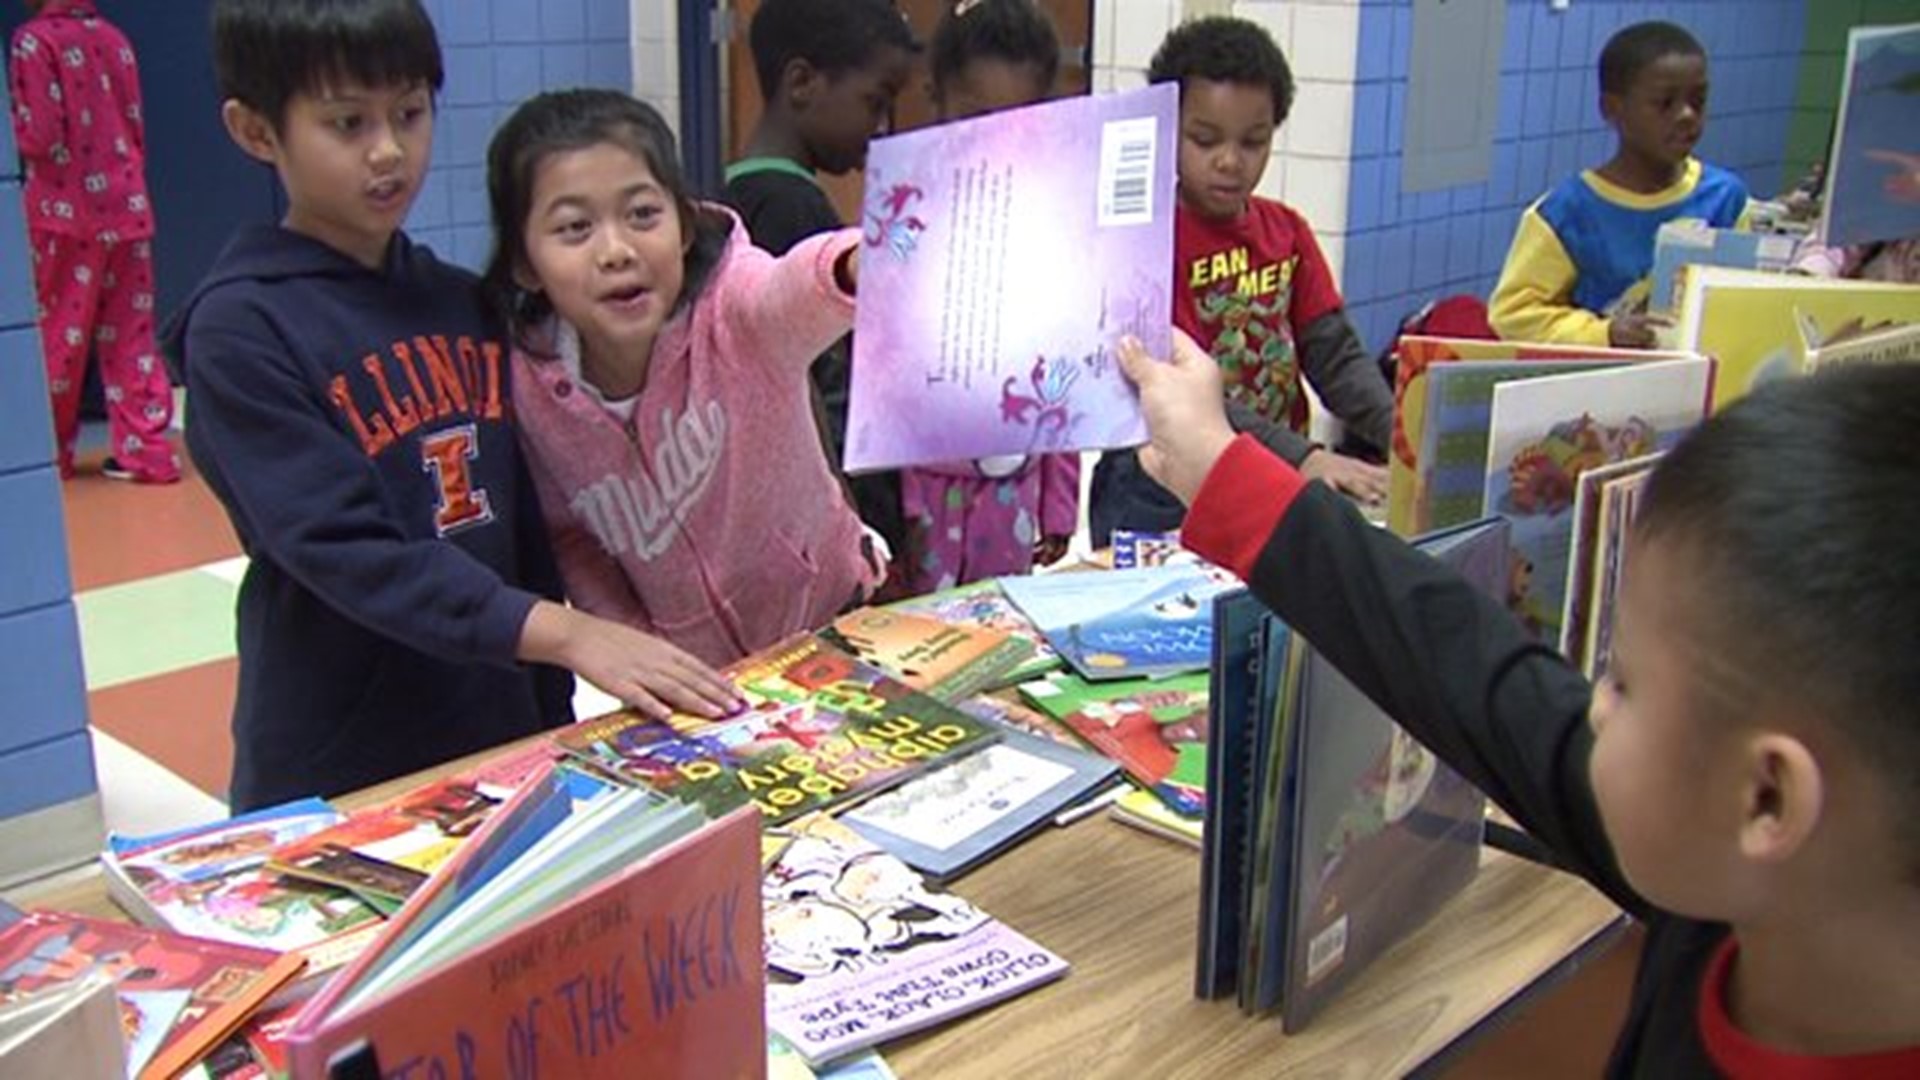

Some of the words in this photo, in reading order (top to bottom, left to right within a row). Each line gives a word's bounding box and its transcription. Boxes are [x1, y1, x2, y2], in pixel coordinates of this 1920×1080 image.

[1190, 246, 1249, 288] EAN
[1236, 253, 1299, 297] MEA
[330, 335, 503, 457] LLINOI
[755, 724, 966, 817] alphabet
[557, 956, 630, 1057] THE
[643, 884, 742, 1023] WEEK
